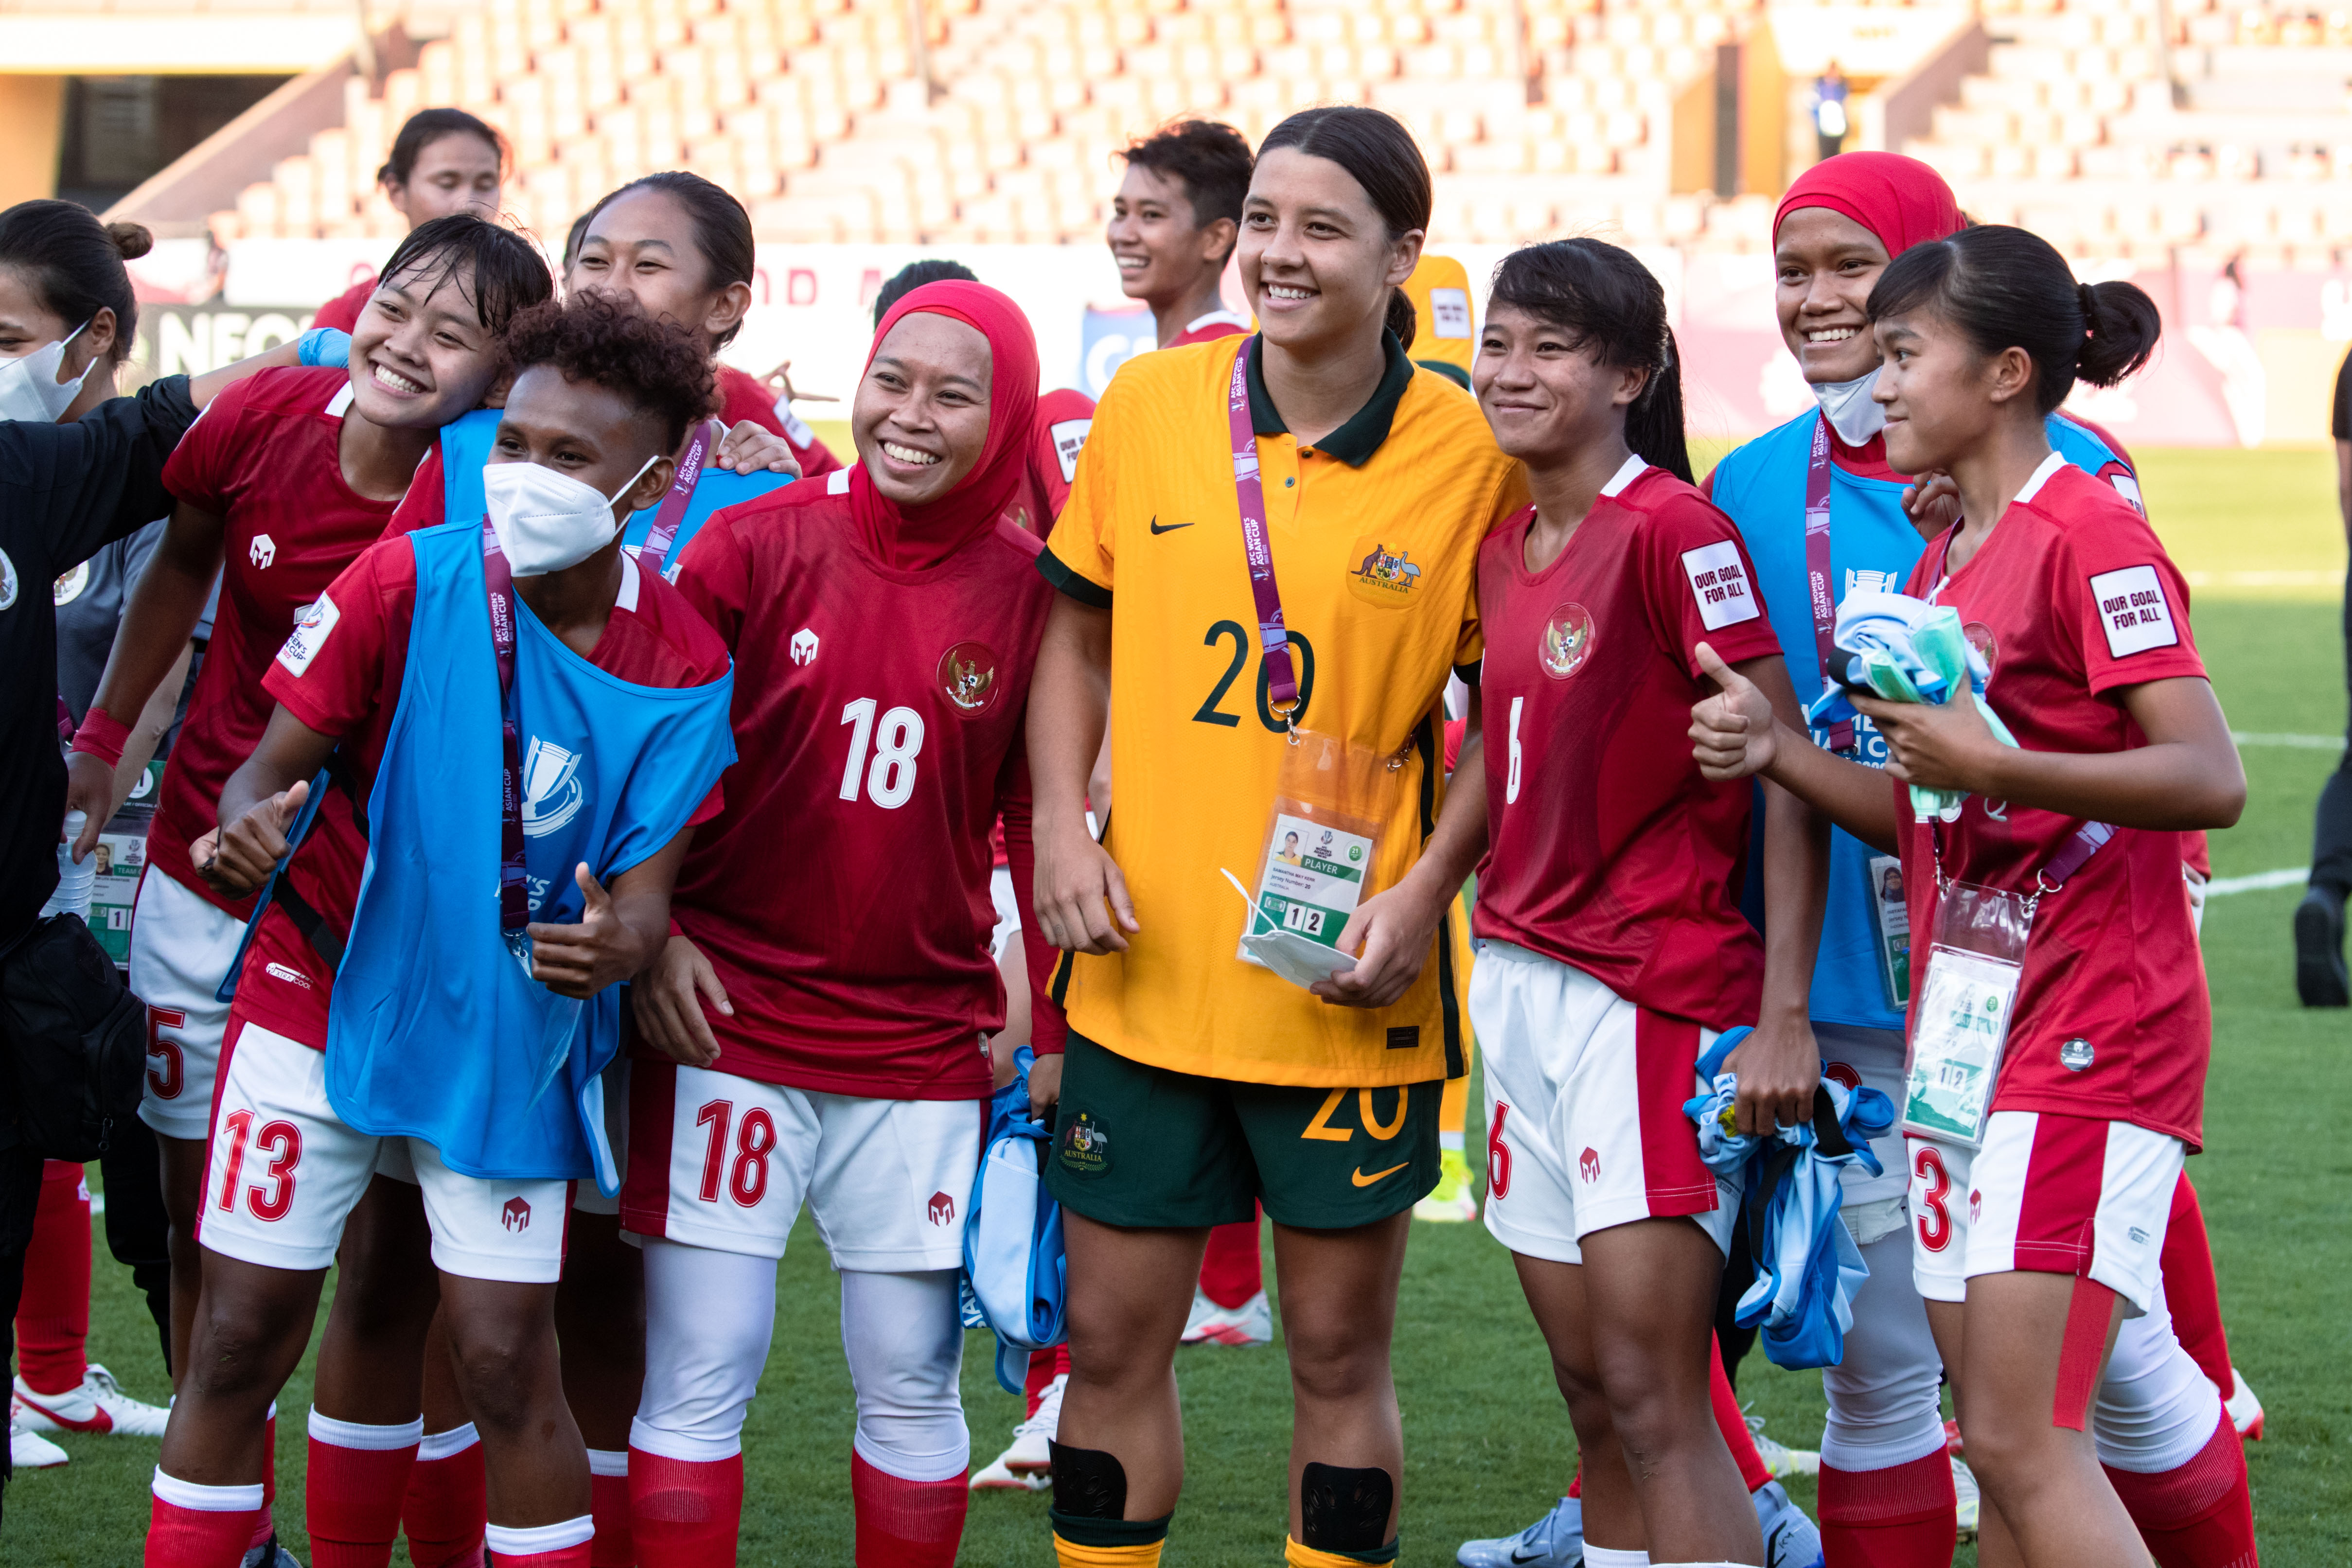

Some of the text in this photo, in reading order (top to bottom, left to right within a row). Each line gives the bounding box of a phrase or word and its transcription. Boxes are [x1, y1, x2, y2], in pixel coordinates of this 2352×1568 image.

[159, 312, 316, 380] NEO
[678, 439, 700, 480] AFC WOMEN'S
[684, 444, 702, 484] ASIAN CUP
[1244, 517, 1255, 551] WOMEN'S
[1251, 519, 1265, 565] ASIAN CUP
[1359, 577, 1408, 594] AUSTRALIA
[1694, 564, 1743, 589] OUR GOAL
[1704, 581, 1744, 604] FOR ALL
[1810, 571, 1819, 605] WOMEN'S
[491, 592, 500, 627] WOMEN'S
[1816, 572, 1828, 618] ASIAN CUP
[2103, 590, 2160, 615] OUR GOAL
[497, 594, 510, 642] ASIAN CUP
[2113, 607, 2161, 630] FOR ALL
[1192, 619, 1314, 734] 20
[839, 697, 924, 809] 18
[1507, 697, 1523, 805] 6
[1273, 867, 1294, 876] SAMANTHA
[1305, 858, 1338, 874] PLAYER
[1269, 882, 1289, 891] AUSTRALIA
[115, 911, 121, 927] 1
[1291, 908, 1320, 932] 1 2
[293, 978, 311, 990] COOL
[1941, 1067, 1963, 1090] 1 2
[219, 1109, 302, 1222] 13
[696, 1099, 777, 1208] 18
[1064, 1149, 1102, 1163] AUSTRALIA
[1488, 1100, 1512, 1200] 6
[1915, 1147, 1952, 1253] 3
